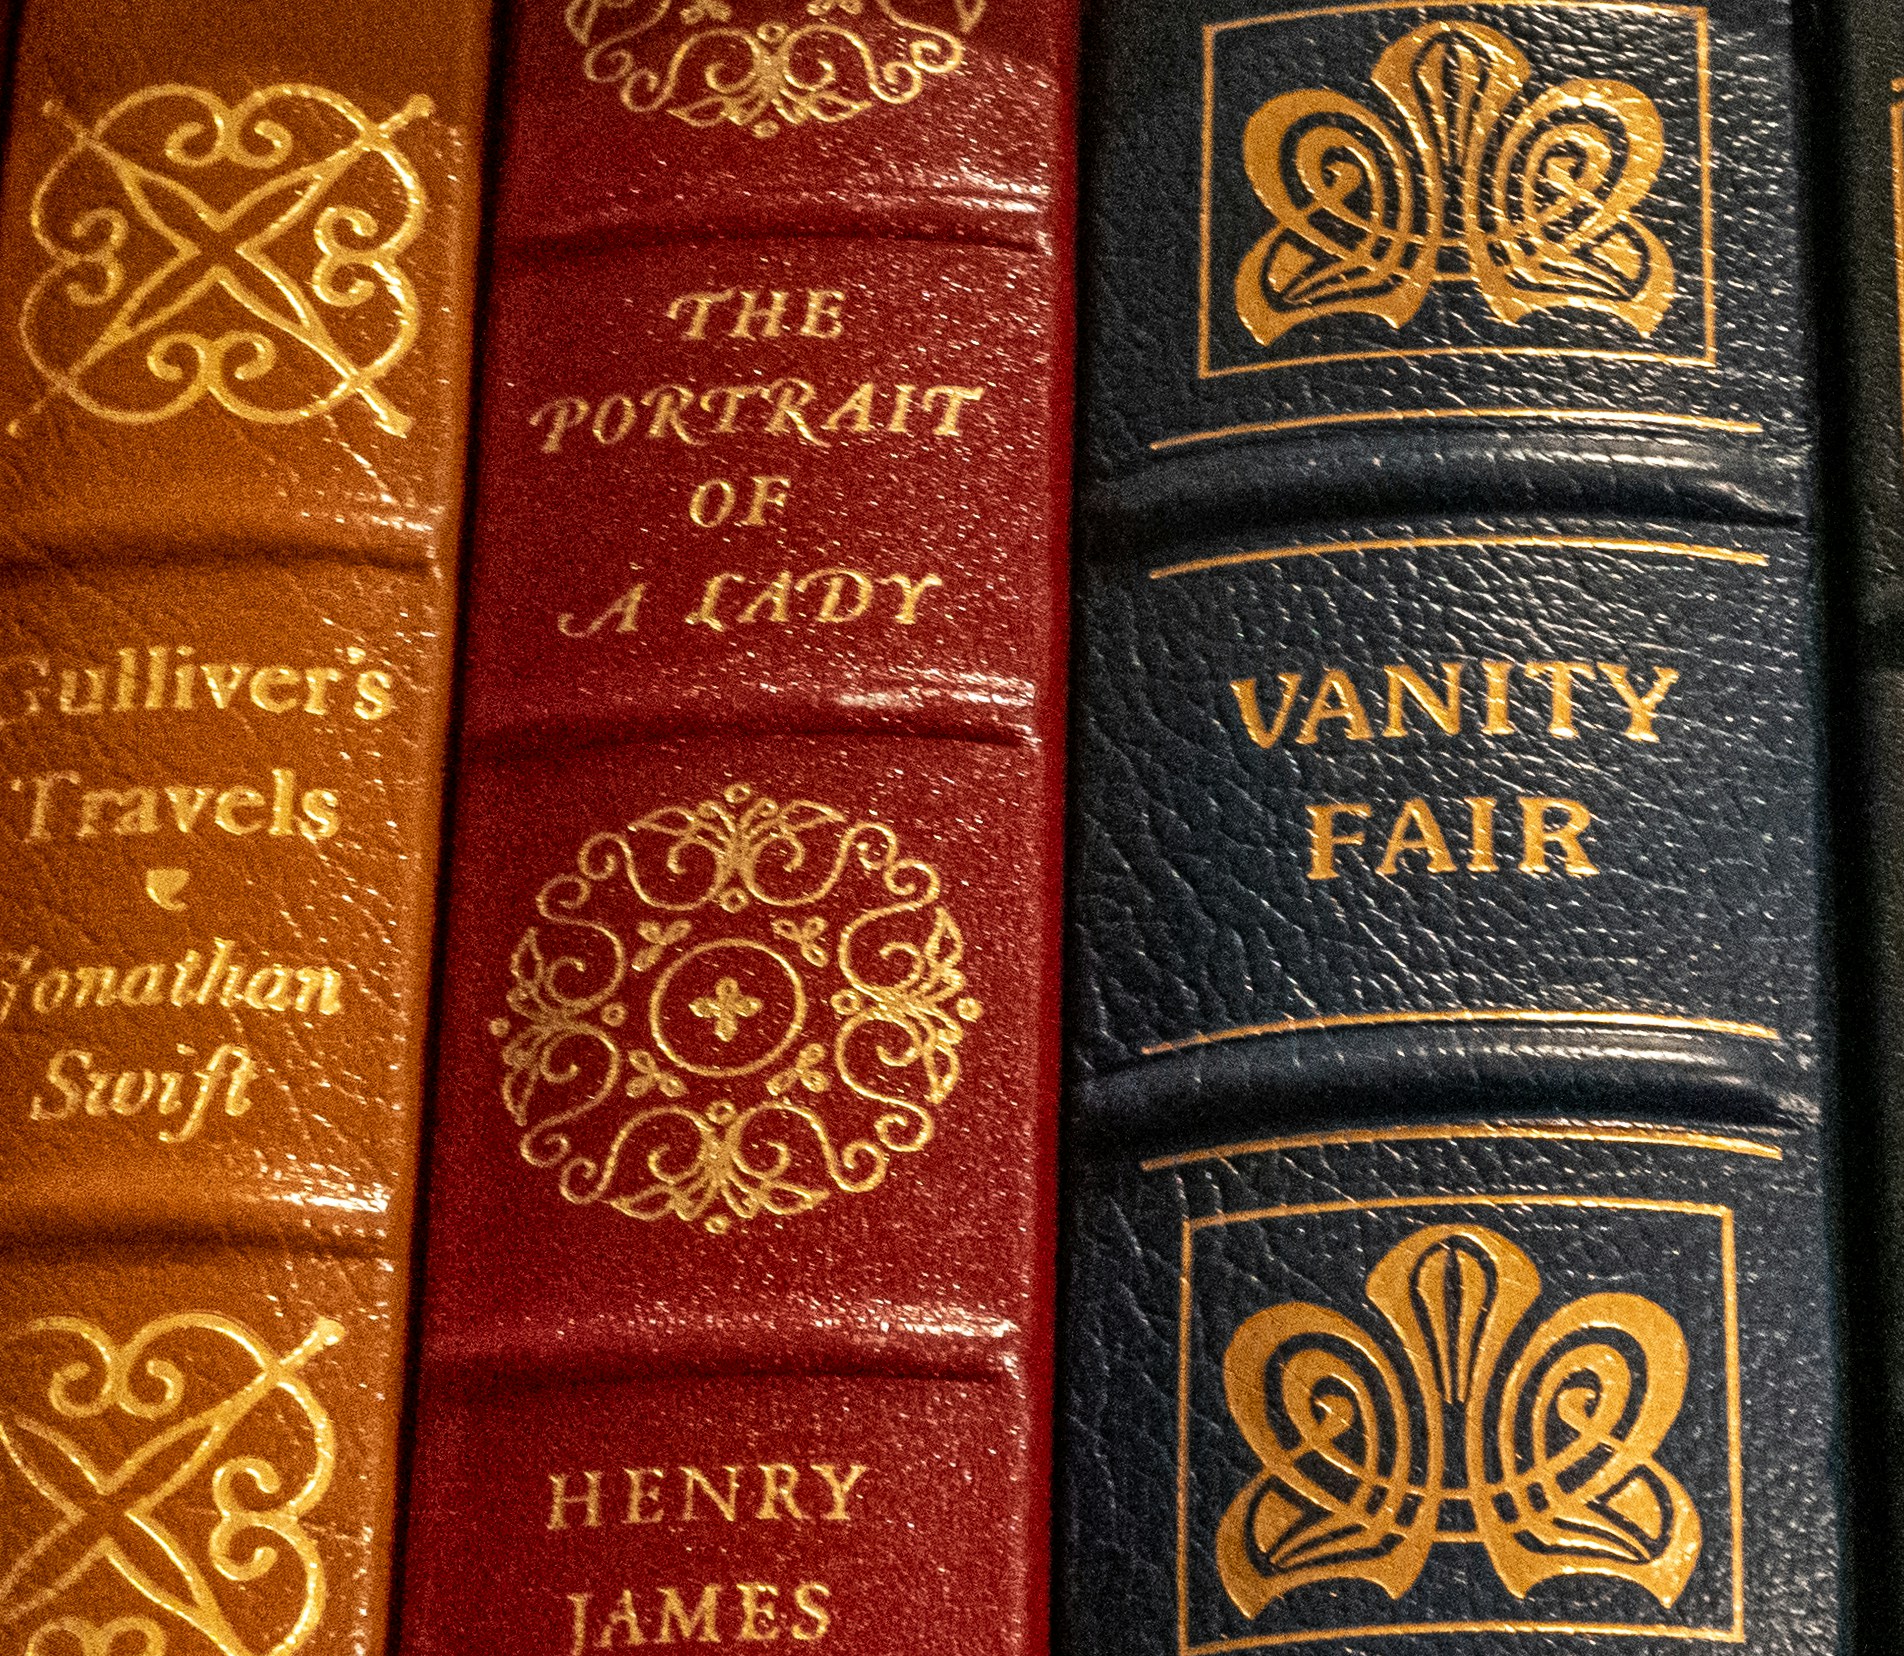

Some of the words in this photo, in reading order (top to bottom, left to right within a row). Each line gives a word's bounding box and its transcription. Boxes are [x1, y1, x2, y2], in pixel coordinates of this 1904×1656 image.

[666, 288, 846, 342] THE
[528, 377, 986, 454] PORTRAIT
[688, 475, 792, 529] OF
[557, 582, 646, 639] A
[684, 568, 943, 633] LADY
[1229, 660, 1681, 750] VANITY
[10, 768, 340, 845] Travels
[1304, 796, 1601, 881] FAIR
[29, 1043, 259, 1144] Swift
[546, 1462, 869, 1532] HENRY
